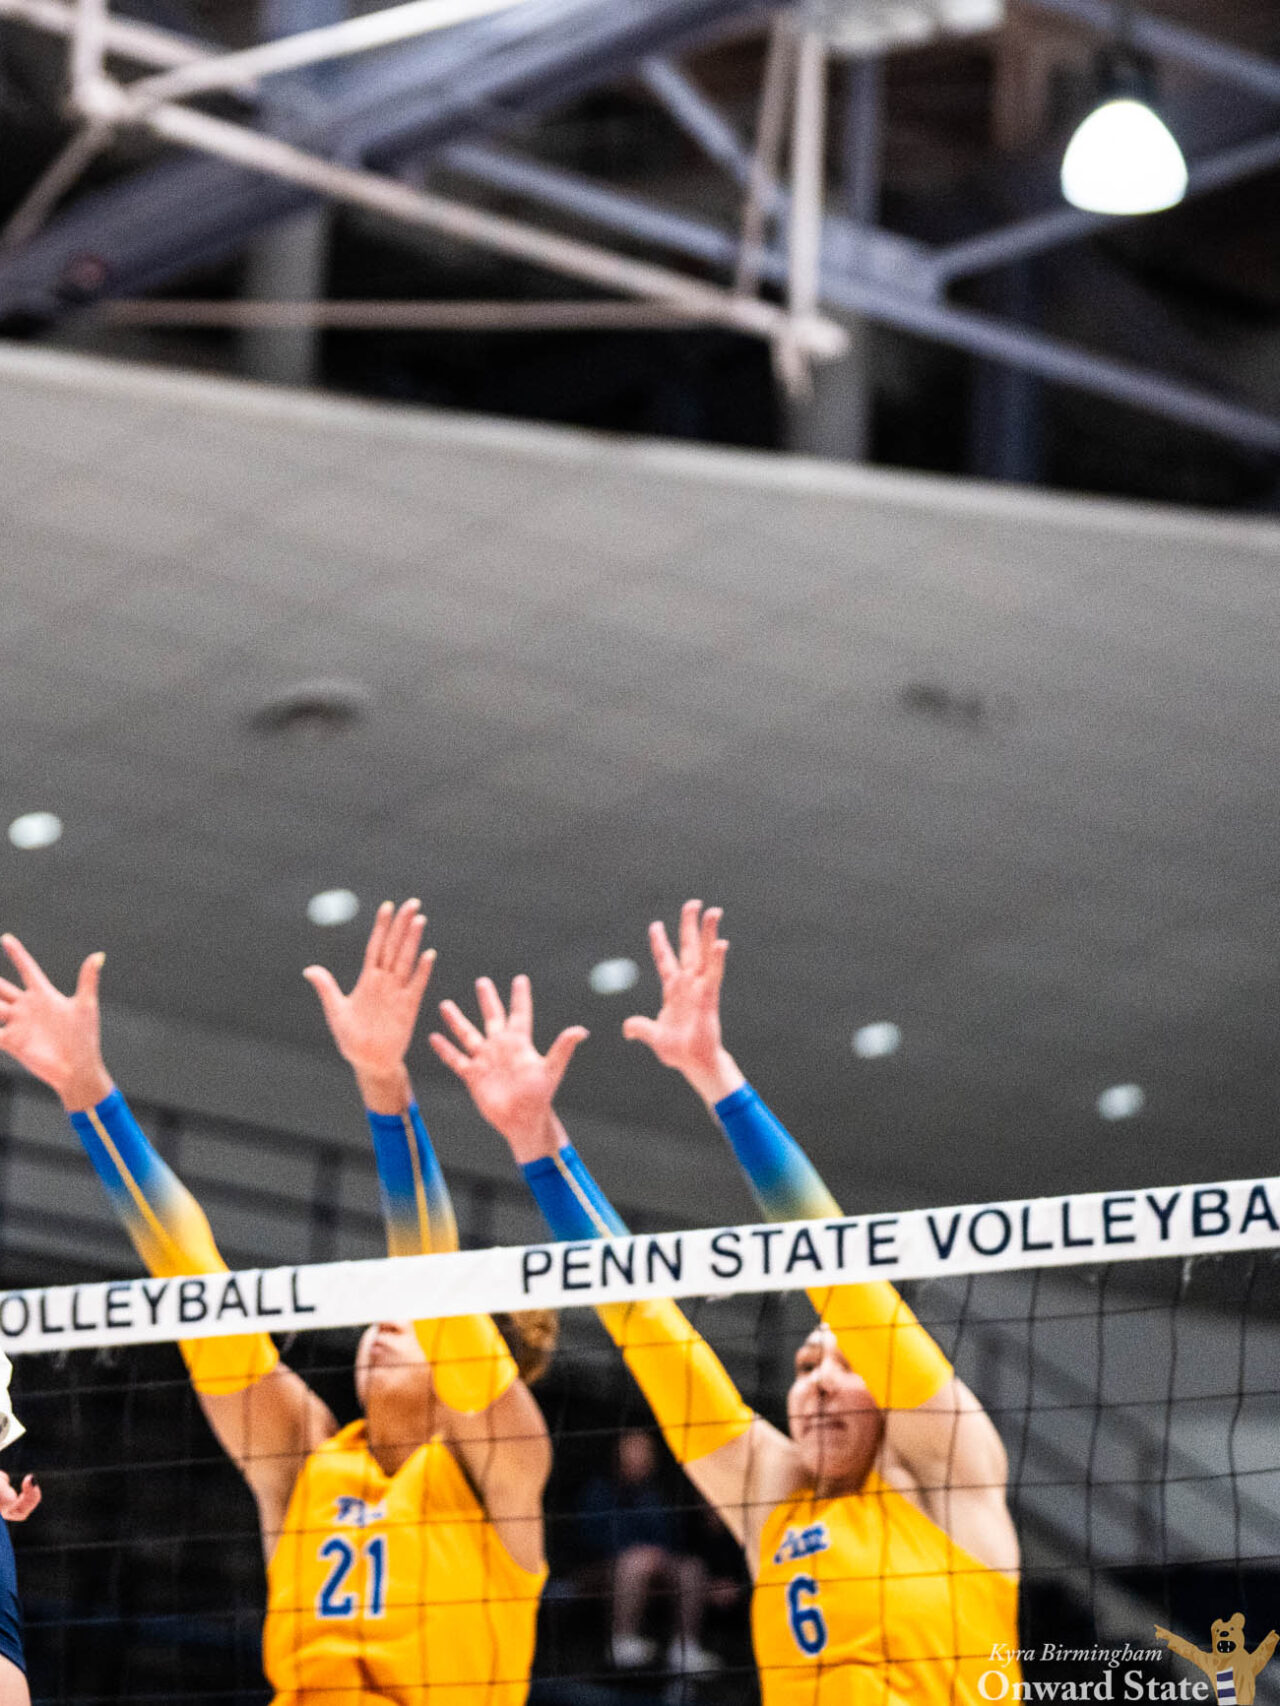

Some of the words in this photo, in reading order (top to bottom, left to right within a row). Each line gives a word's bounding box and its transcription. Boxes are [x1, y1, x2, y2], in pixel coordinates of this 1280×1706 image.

[522, 1237, 682, 1295] PENN
[711, 1219, 899, 1279] STATE
[927, 1184, 1280, 1260] VOLLEYBA
[319, 1536, 385, 1617] 21
[787, 1575, 828, 1656] 6
